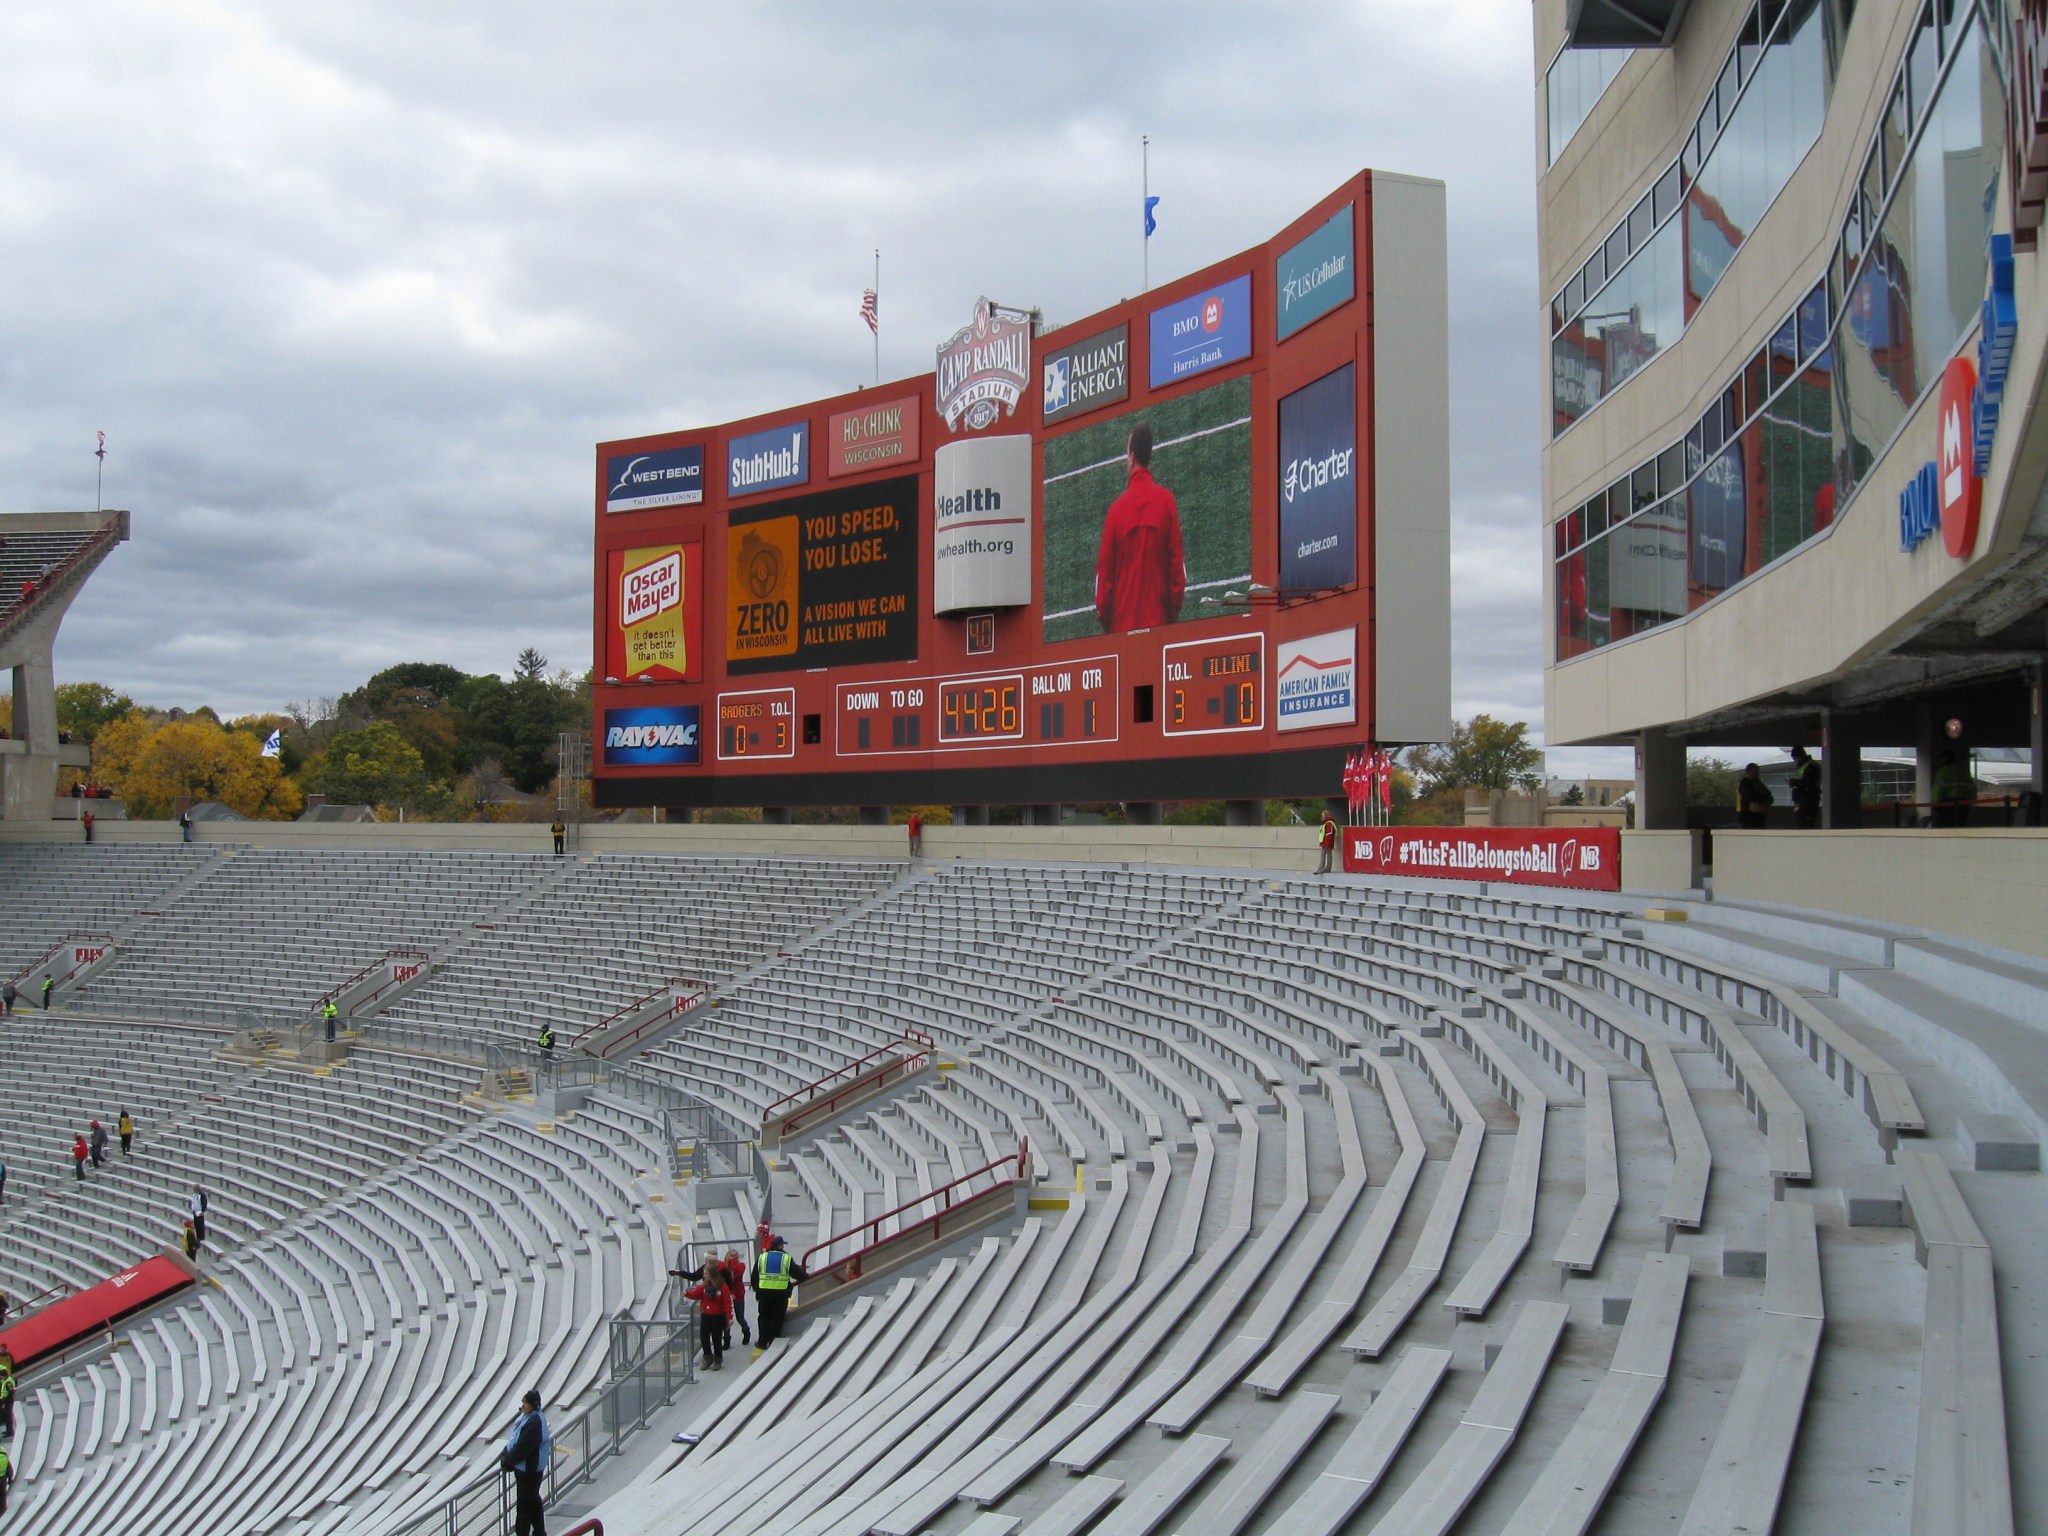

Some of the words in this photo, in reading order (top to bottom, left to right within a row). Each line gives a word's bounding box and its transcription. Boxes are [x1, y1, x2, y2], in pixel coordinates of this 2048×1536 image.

[1311, 255, 1346, 289] Cellular
[1173, 315, 1199, 337] BMO
[940, 350, 971, 402] CAMP
[973, 331, 1026, 379] RANDALL
[1071, 339, 1125, 380] ALLIANT
[1173, 357, 1199, 375] Harris
[1201, 347, 1223, 365] Bank
[951, 383, 1013, 416] STADIUM
[844, 407, 902, 443] HO-CHUNK
[974, 410, 989, 425] 1917
[732, 432, 801, 488] StubHub!
[844, 443, 902, 465] WISCONSIN
[632, 469, 665, 483] WEST
[667, 465, 700, 479] BEND
[1300, 447, 1353, 493] Charter
[633, 499, 646, 507] THE
[648, 496, 669, 505] SILVER
[937, 487, 1001, 520] Health
[805, 515, 836, 542] YOU
[841, 505, 900, 535] SPEED,
[805, 545, 836, 572] YOU
[841, 538, 888, 567] LOSE.
[1297, 534, 1338, 558] charter.com
[630, 562, 675, 595] Oscar
[627, 581, 677, 616] Mayer
[804, 606, 813, 623] A
[815, 600, 855, 622] VISION
[858, 598, 877, 617] WE
[879, 594, 906, 614] CAN
[737, 600, 789, 636] ZERO
[634, 630, 640, 640] it
[643, 628, 675, 640] doesn't
[736, 638, 744, 650] IN
[746, 633, 788, 649] WISCONSIN
[804, 626, 825, 645] ALL
[828, 623, 853, 643] LIVE
[855, 619, 887, 639] WITH
[969, 619, 991, 648] 40
[633, 641, 647, 653] get
[650, 640, 677, 650] better
[638, 652, 656, 661] than
[659, 650, 674, 660] this
[1166, 661, 1192, 682] T.O.L.
[1209, 654, 1251, 676] ILLINI
[1032, 674, 1055, 695] BALL
[1057, 672, 1071, 692] ON
[1082, 668, 1102, 690] QTR
[1280, 676, 1319, 697] AMERICAN
[1321, 671, 1351, 690] FAMILY
[721, 703, 763, 719] BADGERS
[770, 701, 791, 717] T.O.L.
[846, 692, 879, 711] DOWN
[891, 691, 905, 708] TO
[908, 689, 924, 707] GO
[1174, 689, 1185, 724] 3
[1239, 682, 1254, 723] 0
[1284, 693, 1345, 712] INSURANCE
[606, 723, 697, 748] RAYOVAC
[735, 725, 747, 754] 0
[777, 722, 786, 748] 3
[1400, 839, 1557, 877] #ThisFallBelongstoBall
